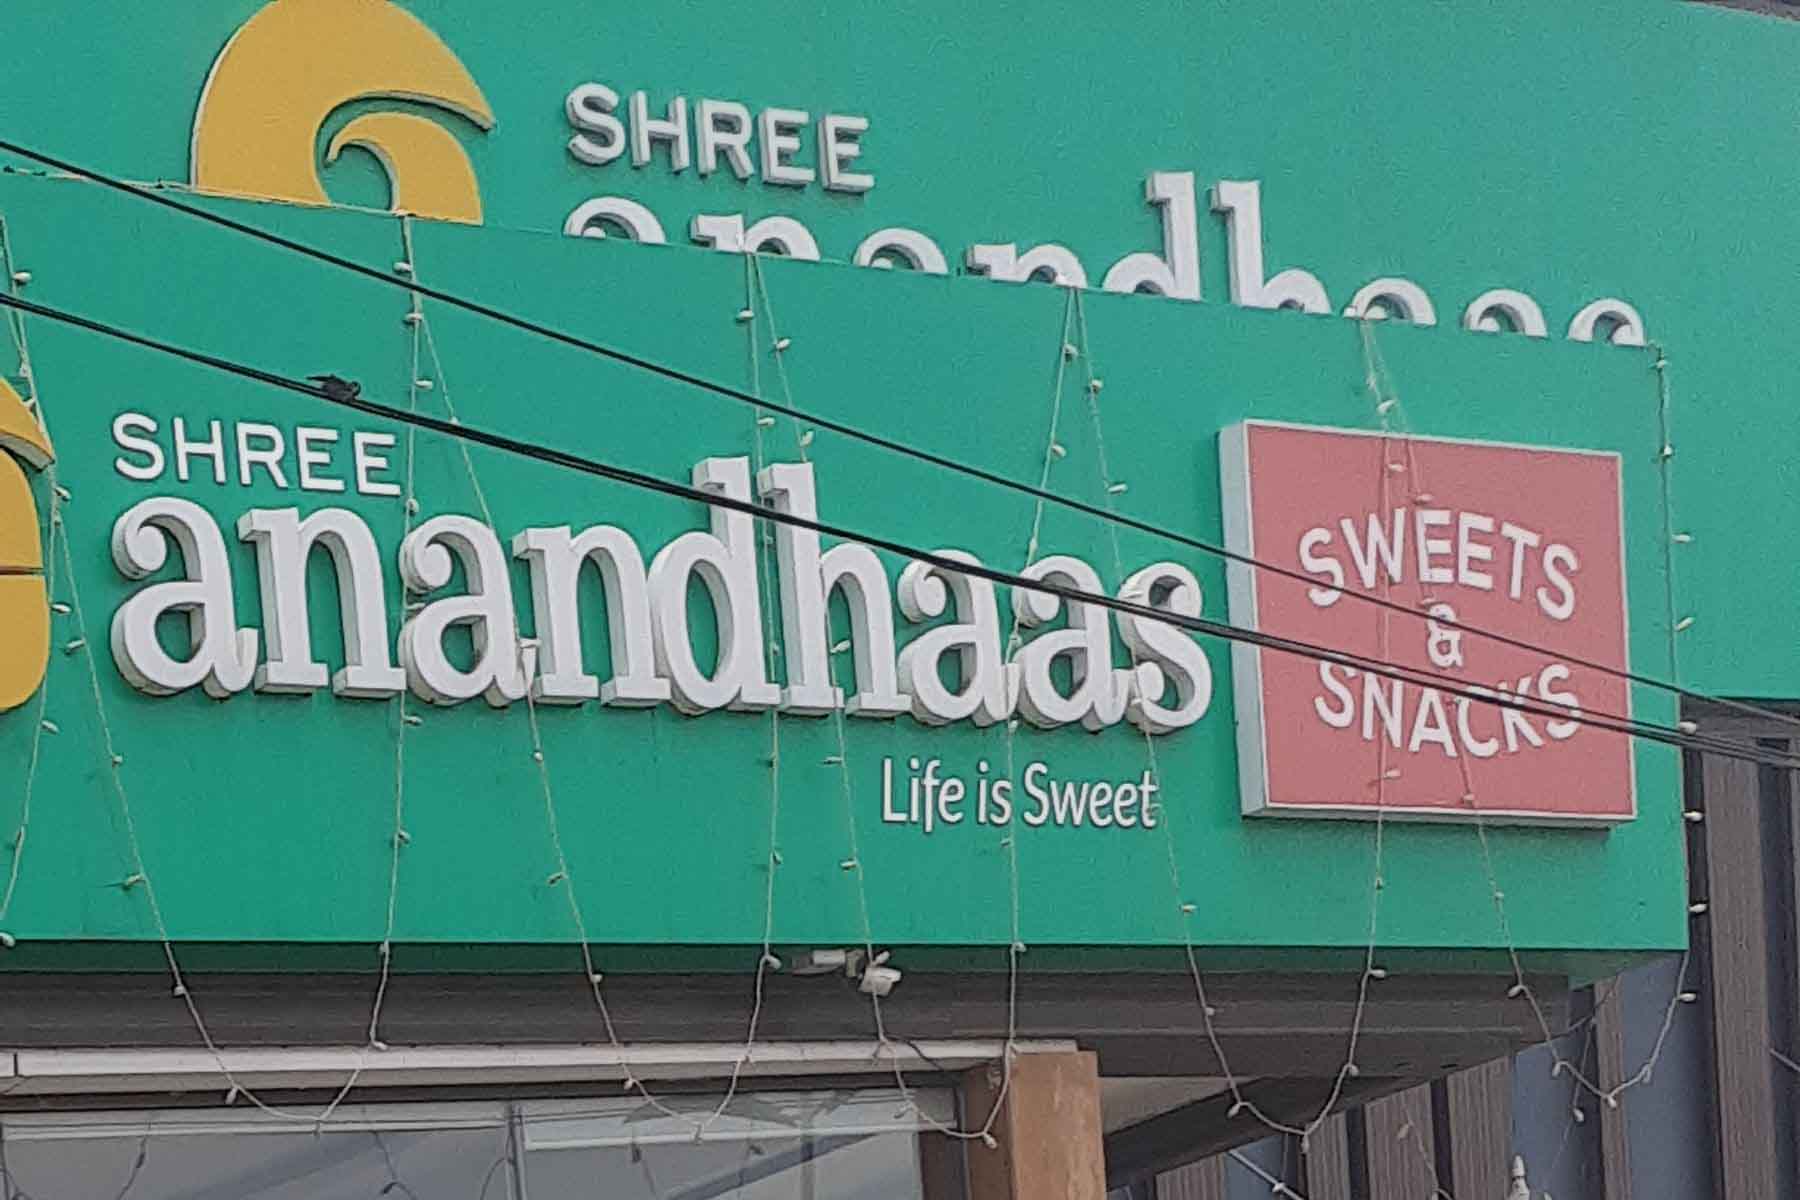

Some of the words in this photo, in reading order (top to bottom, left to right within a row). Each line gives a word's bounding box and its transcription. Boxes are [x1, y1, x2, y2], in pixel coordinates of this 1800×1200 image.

[565, 81, 876, 192] SHREE
[112, 411, 401, 497] SHREE
[111, 456, 1212, 736] anandhaas
[1298, 508, 1578, 621] SWEETS
[1315, 660, 1581, 758] SNACKS
[882, 757, 965, 832] Life
[978, 760, 1013, 825] is
[1022, 761, 1157, 828] Sweet
